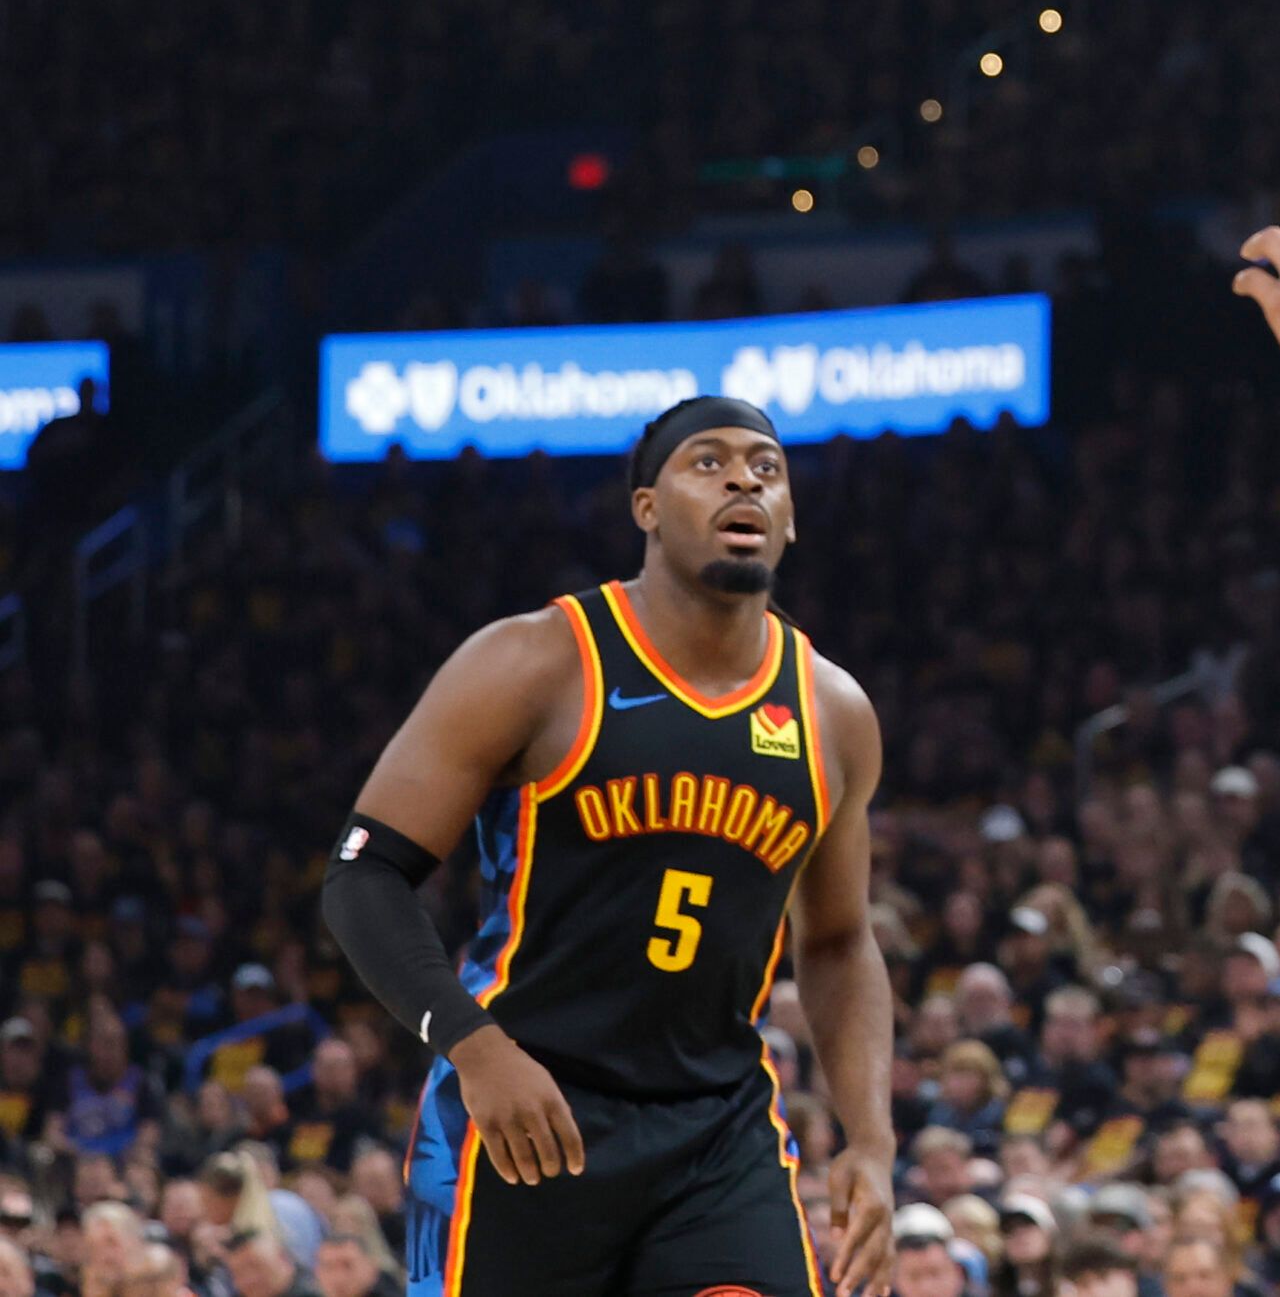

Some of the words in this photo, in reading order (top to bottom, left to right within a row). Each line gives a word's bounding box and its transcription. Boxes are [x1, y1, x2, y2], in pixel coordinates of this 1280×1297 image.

[818, 339, 1026, 406] Oklahoma
[575, 771, 810, 874] OKLAHOMA
[646, 868, 713, 972] 5
